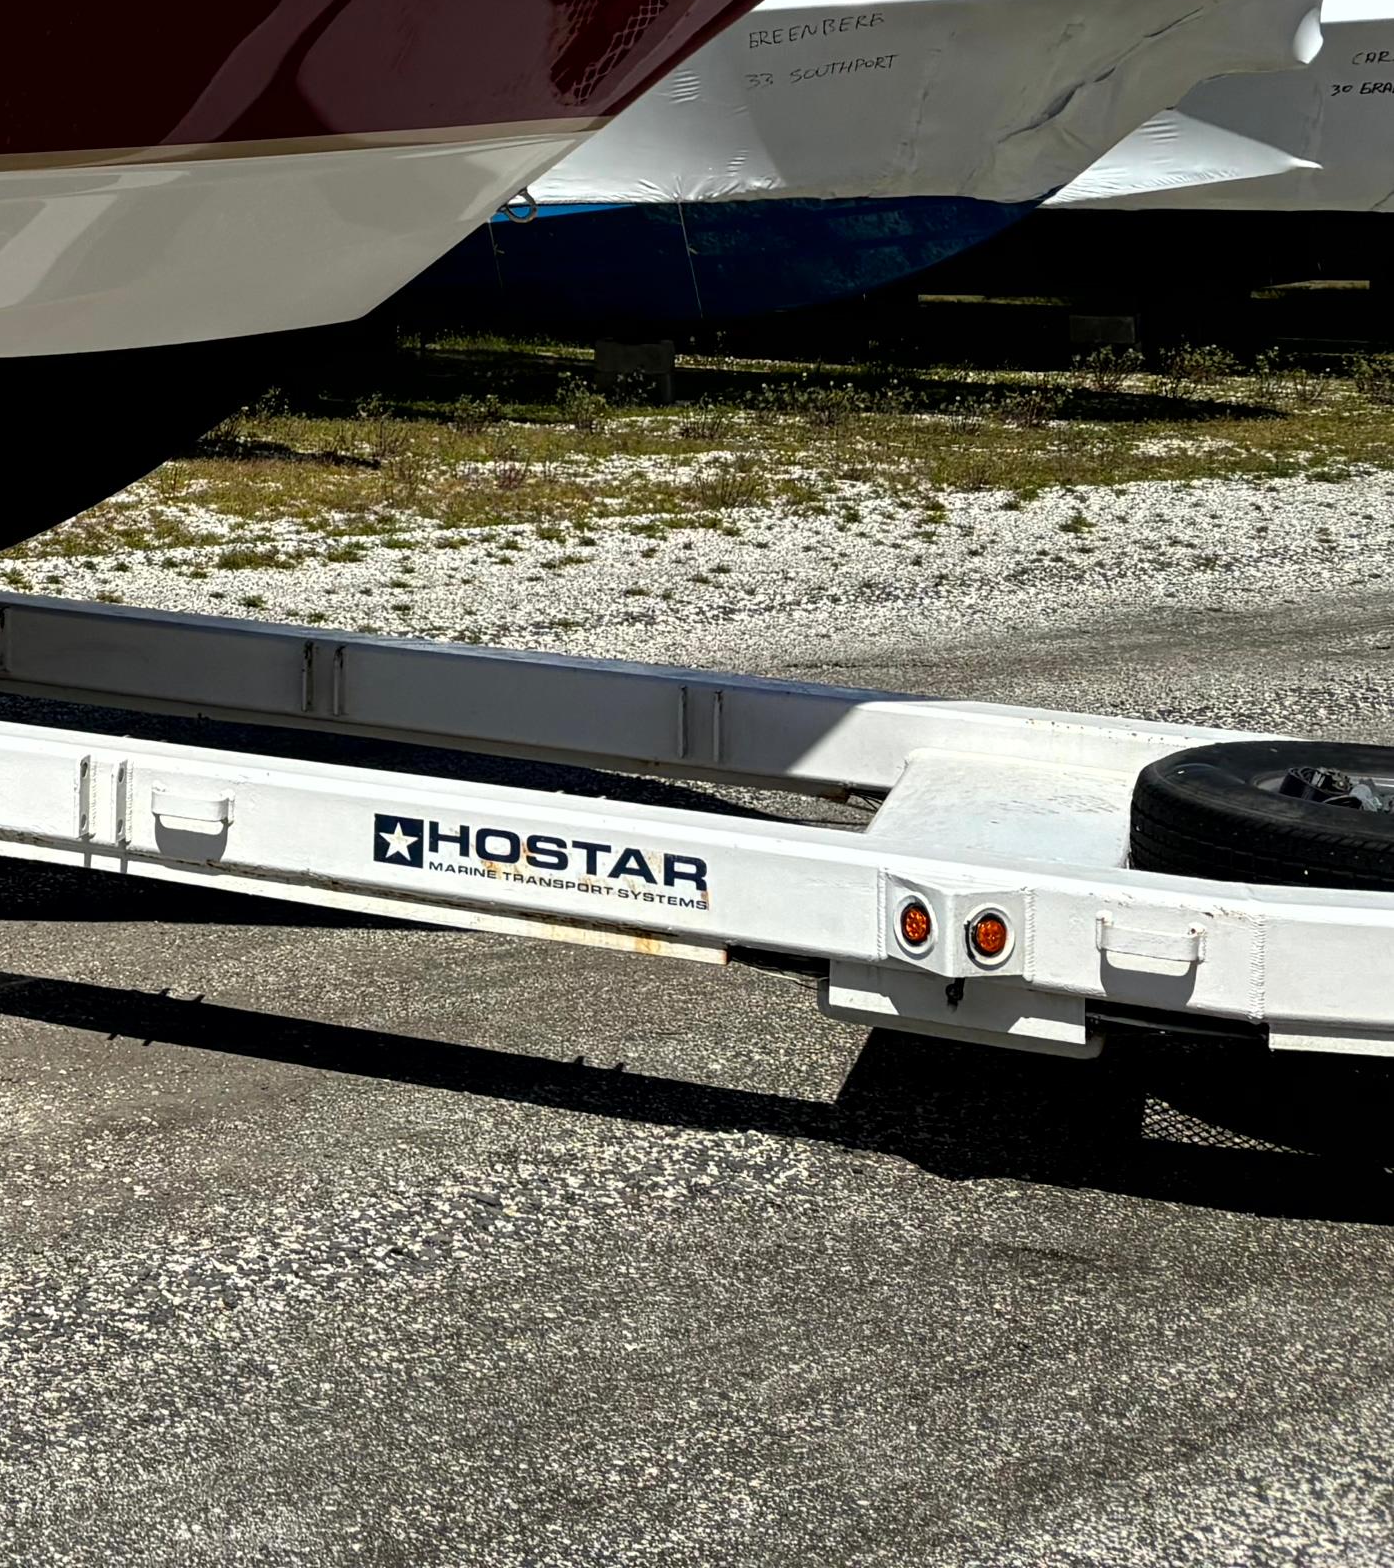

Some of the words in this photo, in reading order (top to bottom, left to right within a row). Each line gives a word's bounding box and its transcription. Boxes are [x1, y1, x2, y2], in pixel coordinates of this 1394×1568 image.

[790, 54, 898, 84] SOUTHPORT
[1331, 84, 1353, 96] 30
[1359, 82, 1394, 95] GRA
[428, 820, 708, 892] HOSTAR
[429, 861, 497, 880] MARINE
[502, 872, 613, 896] TRANSPORT
[617, 888, 708, 911] SYSTEMS
